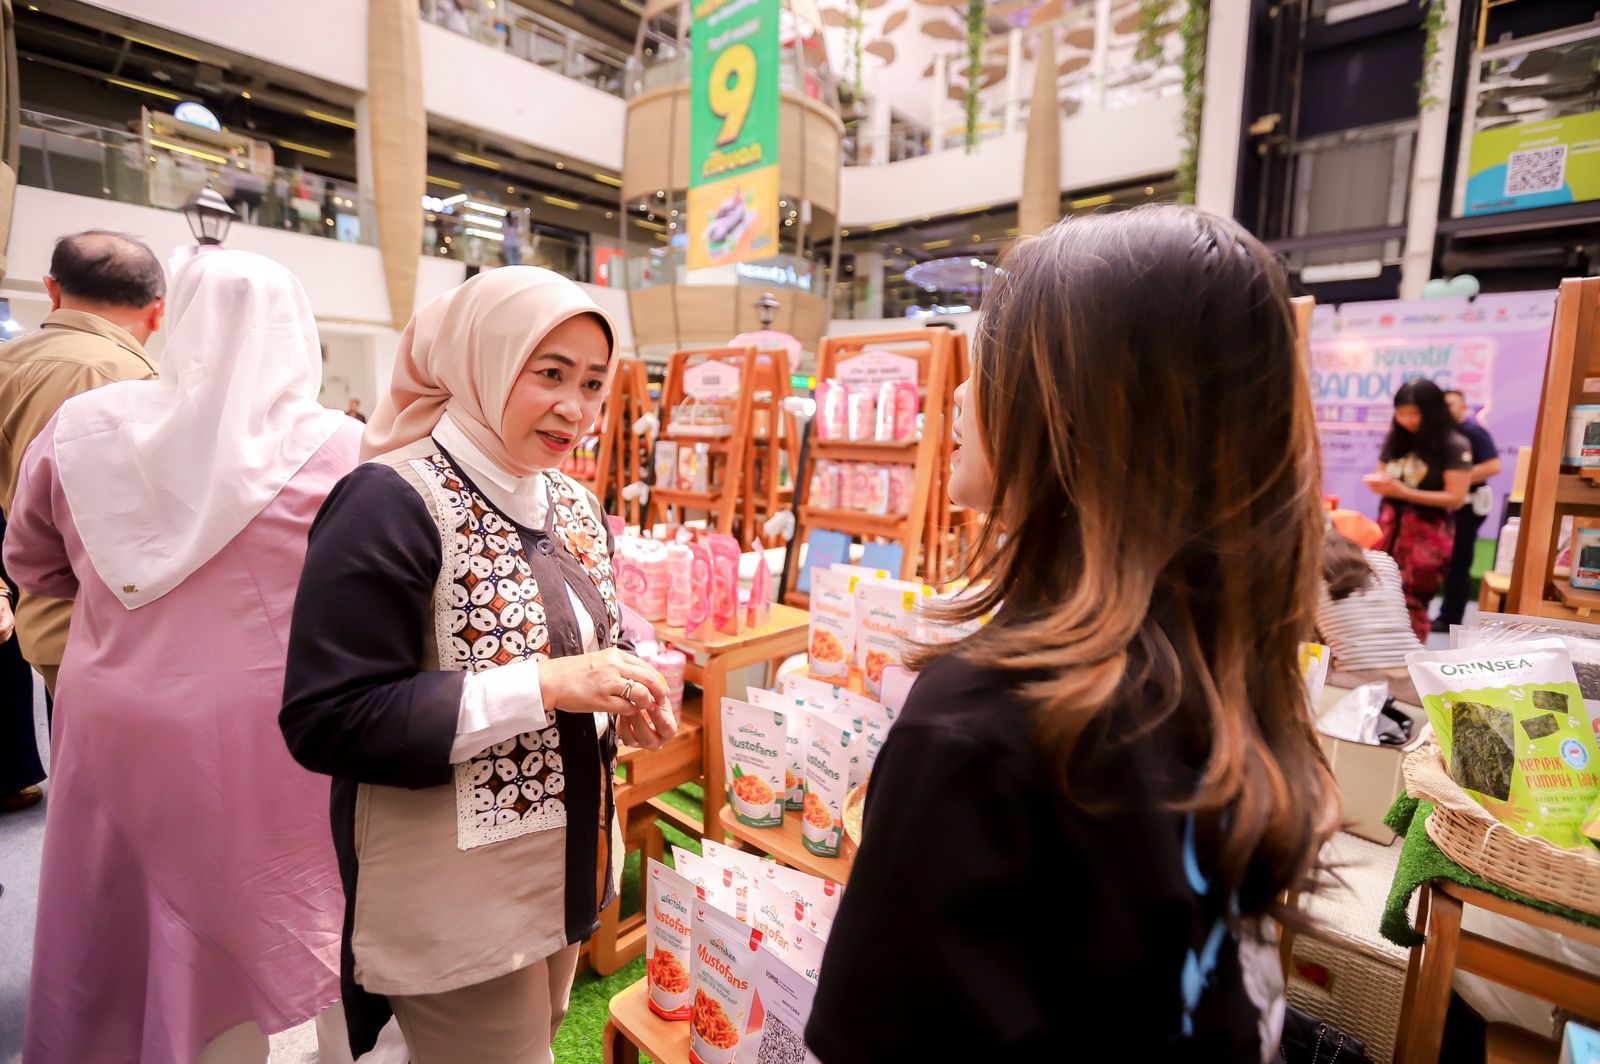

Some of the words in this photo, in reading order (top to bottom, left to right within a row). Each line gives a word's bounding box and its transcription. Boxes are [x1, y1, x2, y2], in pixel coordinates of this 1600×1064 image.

[708, 43, 757, 148] 9
[807, 753, 840, 780] ustofans
[697, 943, 749, 990] Mustofans
